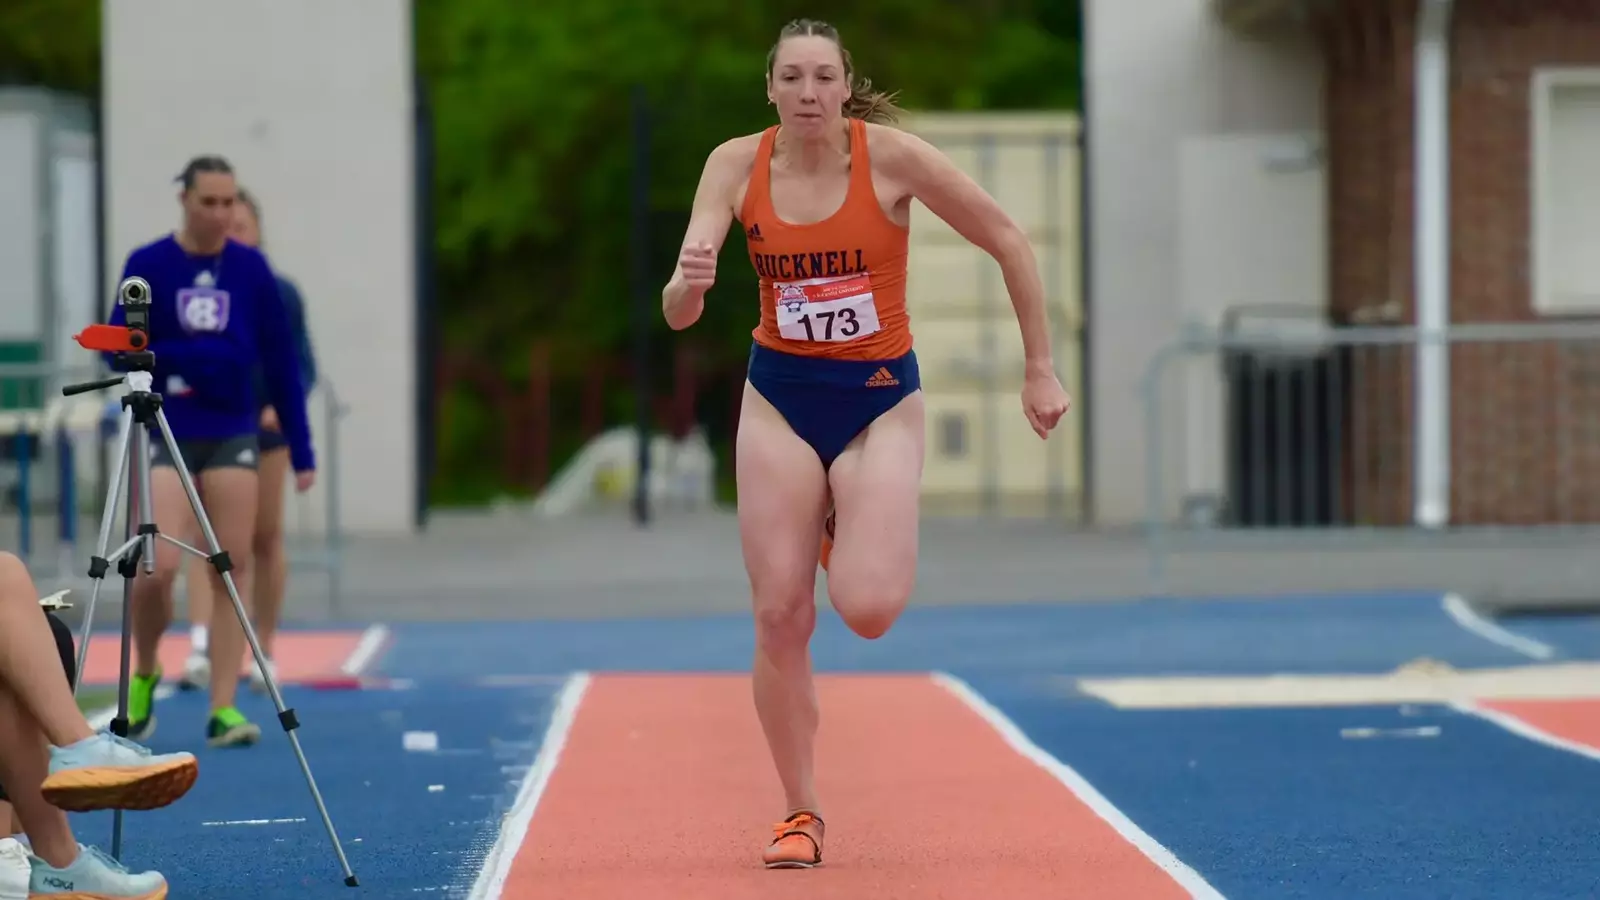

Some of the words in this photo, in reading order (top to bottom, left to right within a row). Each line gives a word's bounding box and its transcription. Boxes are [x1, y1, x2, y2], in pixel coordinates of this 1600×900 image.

[755, 249, 867, 279] BUCKNELL
[797, 308, 860, 341] 173
[865, 379, 899, 387] adidas
[43, 877, 74, 891] HOKA
